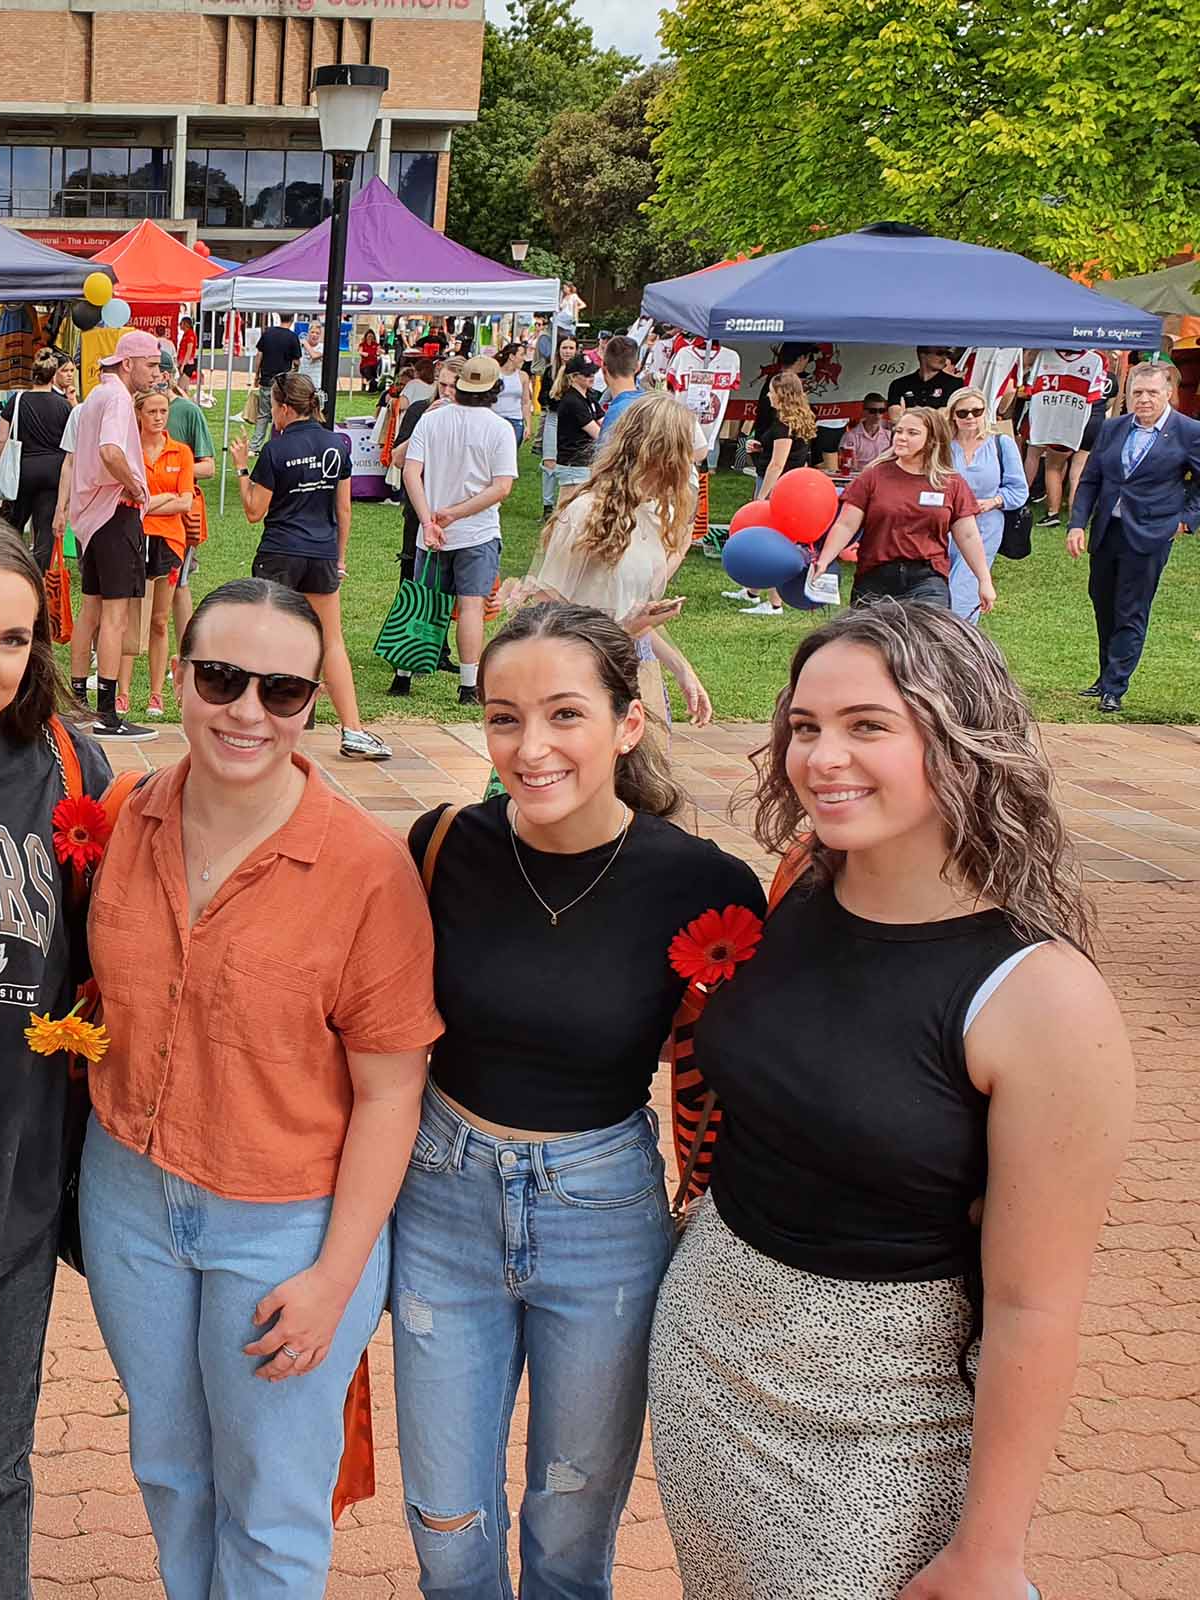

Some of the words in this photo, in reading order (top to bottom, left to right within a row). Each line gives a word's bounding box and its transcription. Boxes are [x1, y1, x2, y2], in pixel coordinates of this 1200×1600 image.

[67, 237, 81, 245] The
[84, 237, 111, 247] Library
[869, 362, 906, 376] 1963
[1042, 375, 1060, 390] 34
